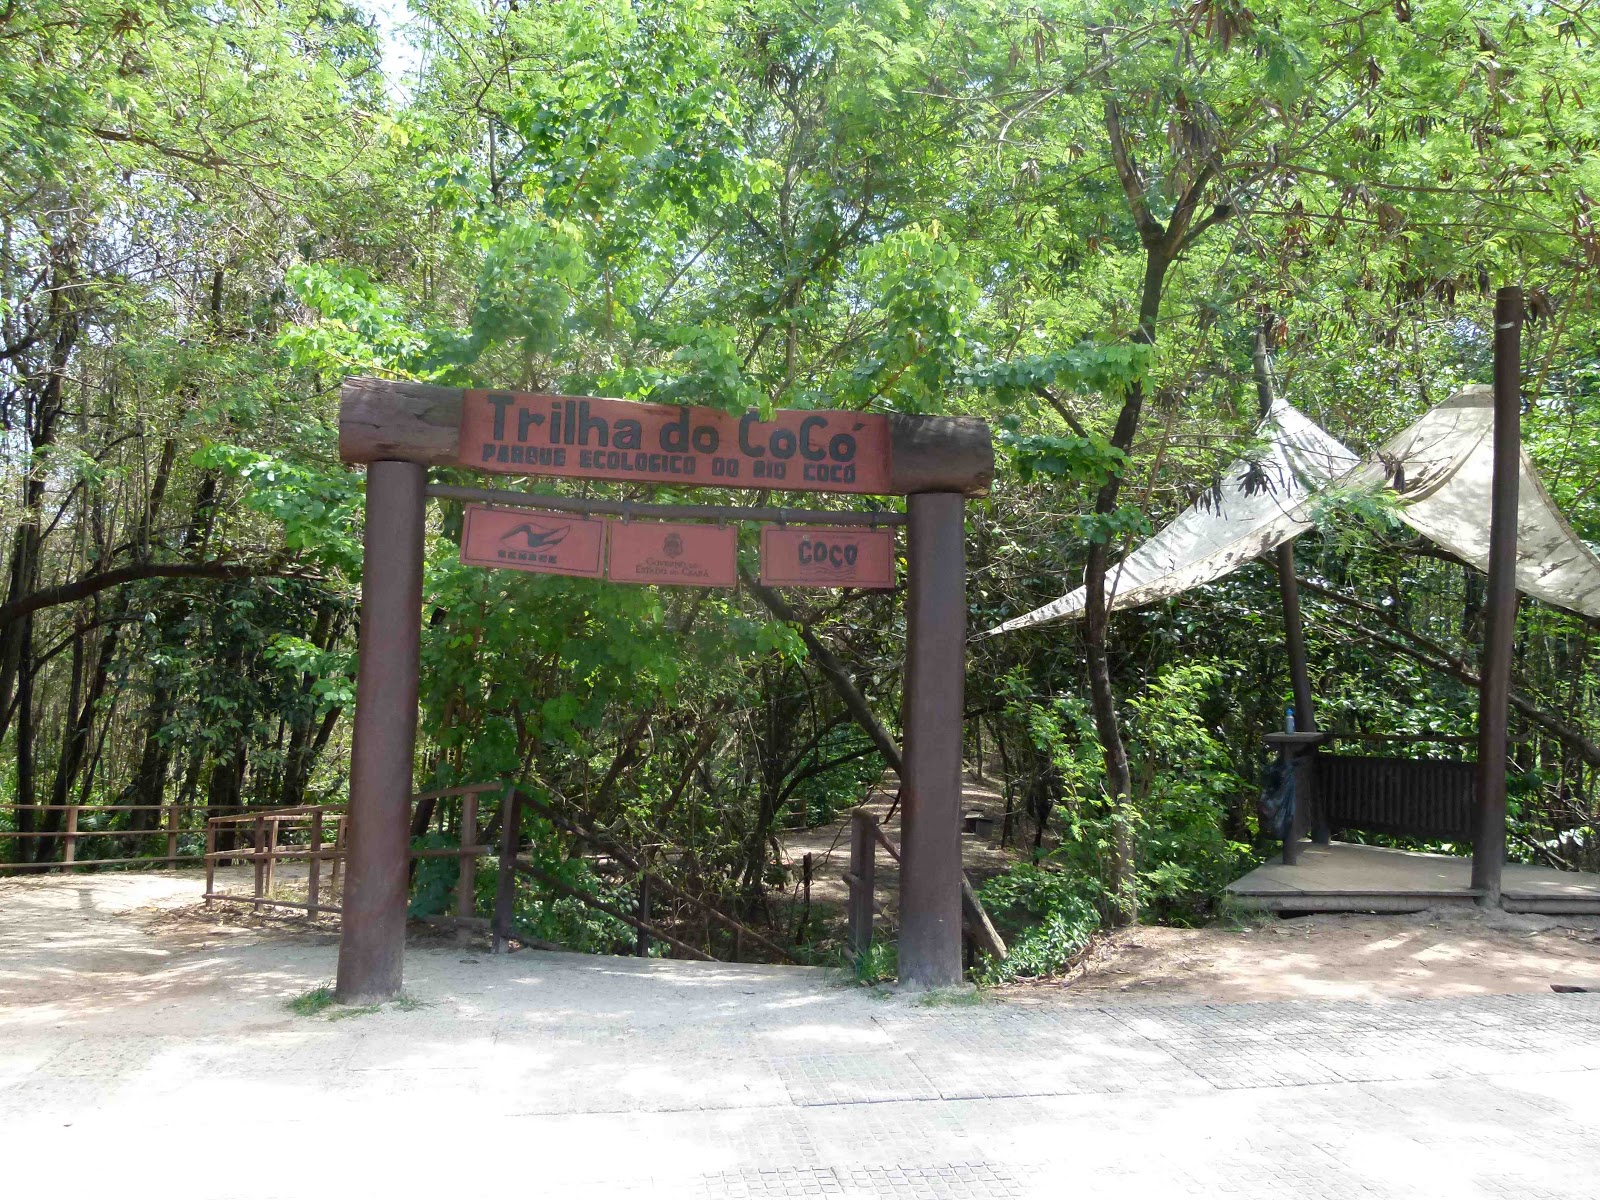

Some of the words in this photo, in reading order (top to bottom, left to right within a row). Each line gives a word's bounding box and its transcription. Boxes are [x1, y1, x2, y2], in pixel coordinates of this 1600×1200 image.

[486, 395, 642, 450] Trilha
[659, 407, 720, 454] do
[482, 443, 566, 467] PARQUE
[711, 457, 739, 478] DO
[753, 460, 787, 480] RIO
